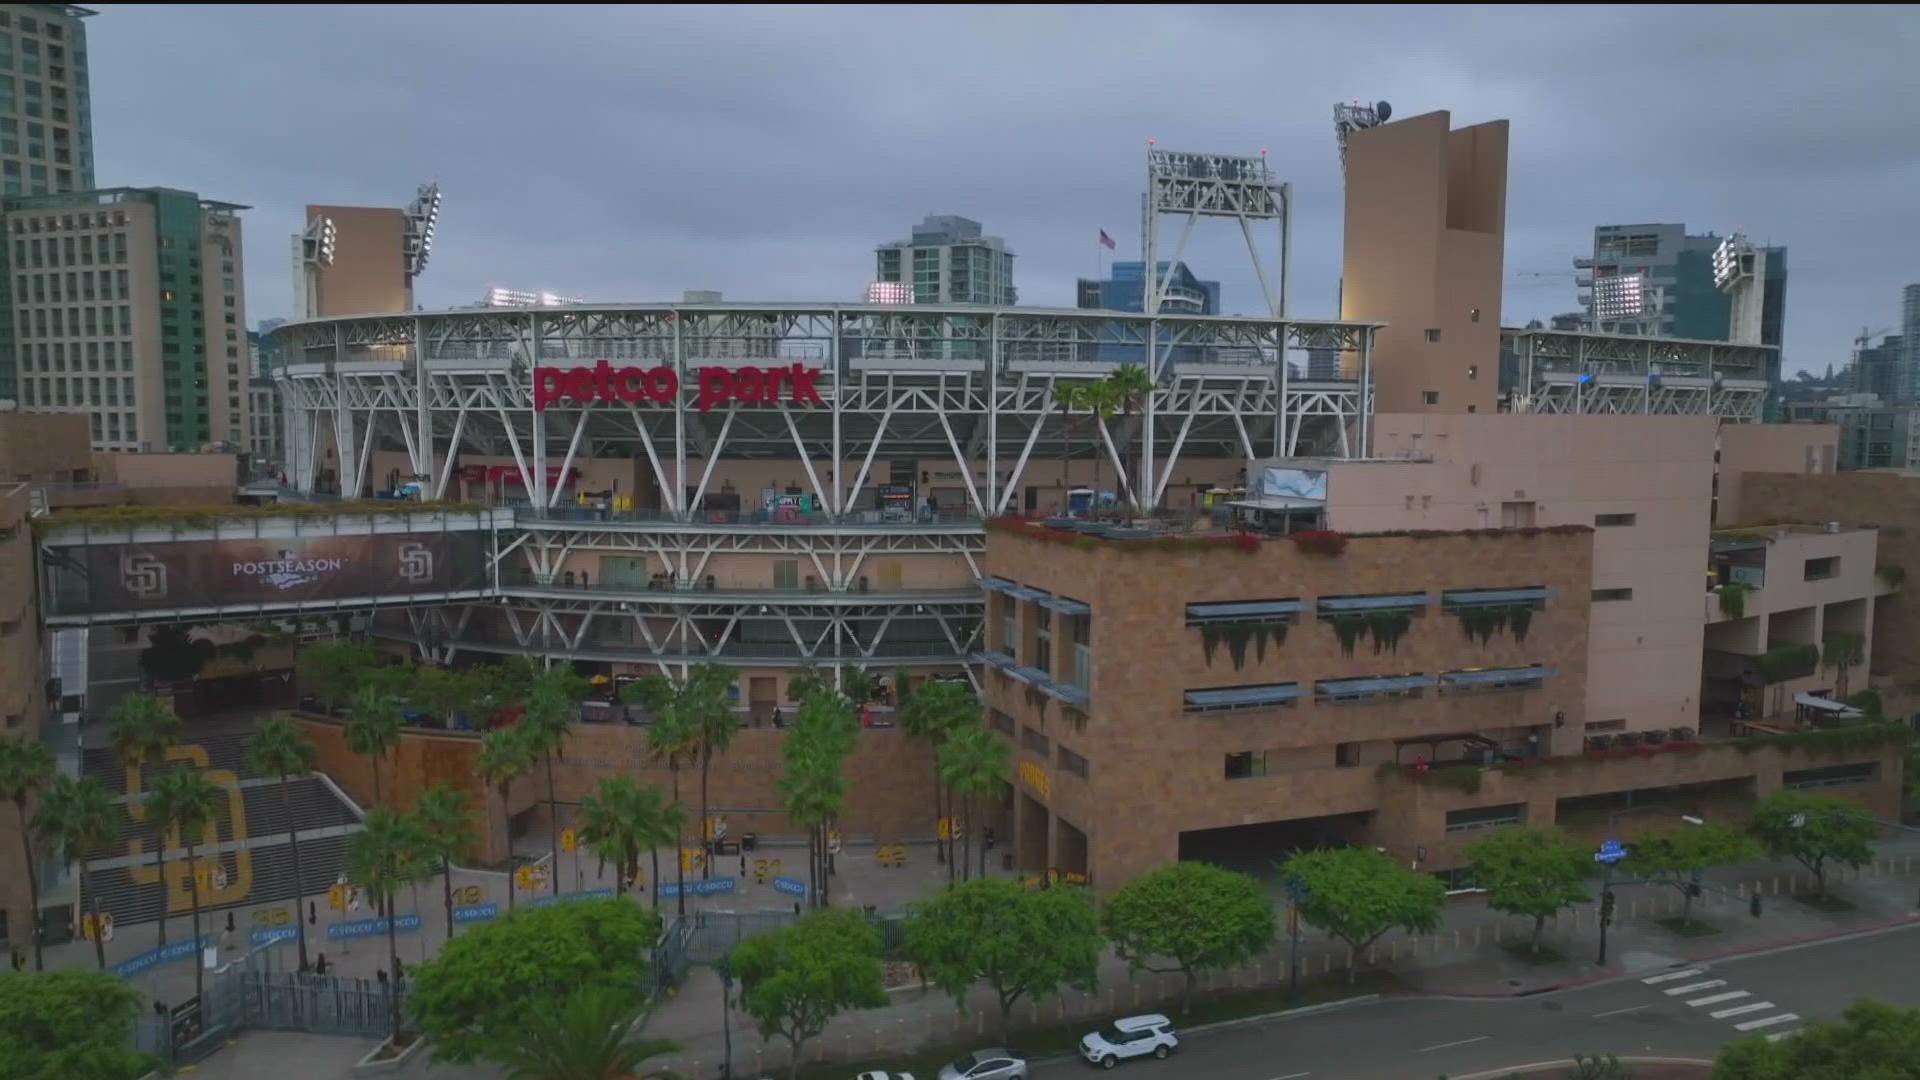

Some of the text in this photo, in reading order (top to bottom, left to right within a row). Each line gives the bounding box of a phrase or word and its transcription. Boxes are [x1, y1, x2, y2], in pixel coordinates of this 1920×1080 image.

[534, 360, 821, 414] petco park
[232, 558, 341, 576] POSTSEASON
